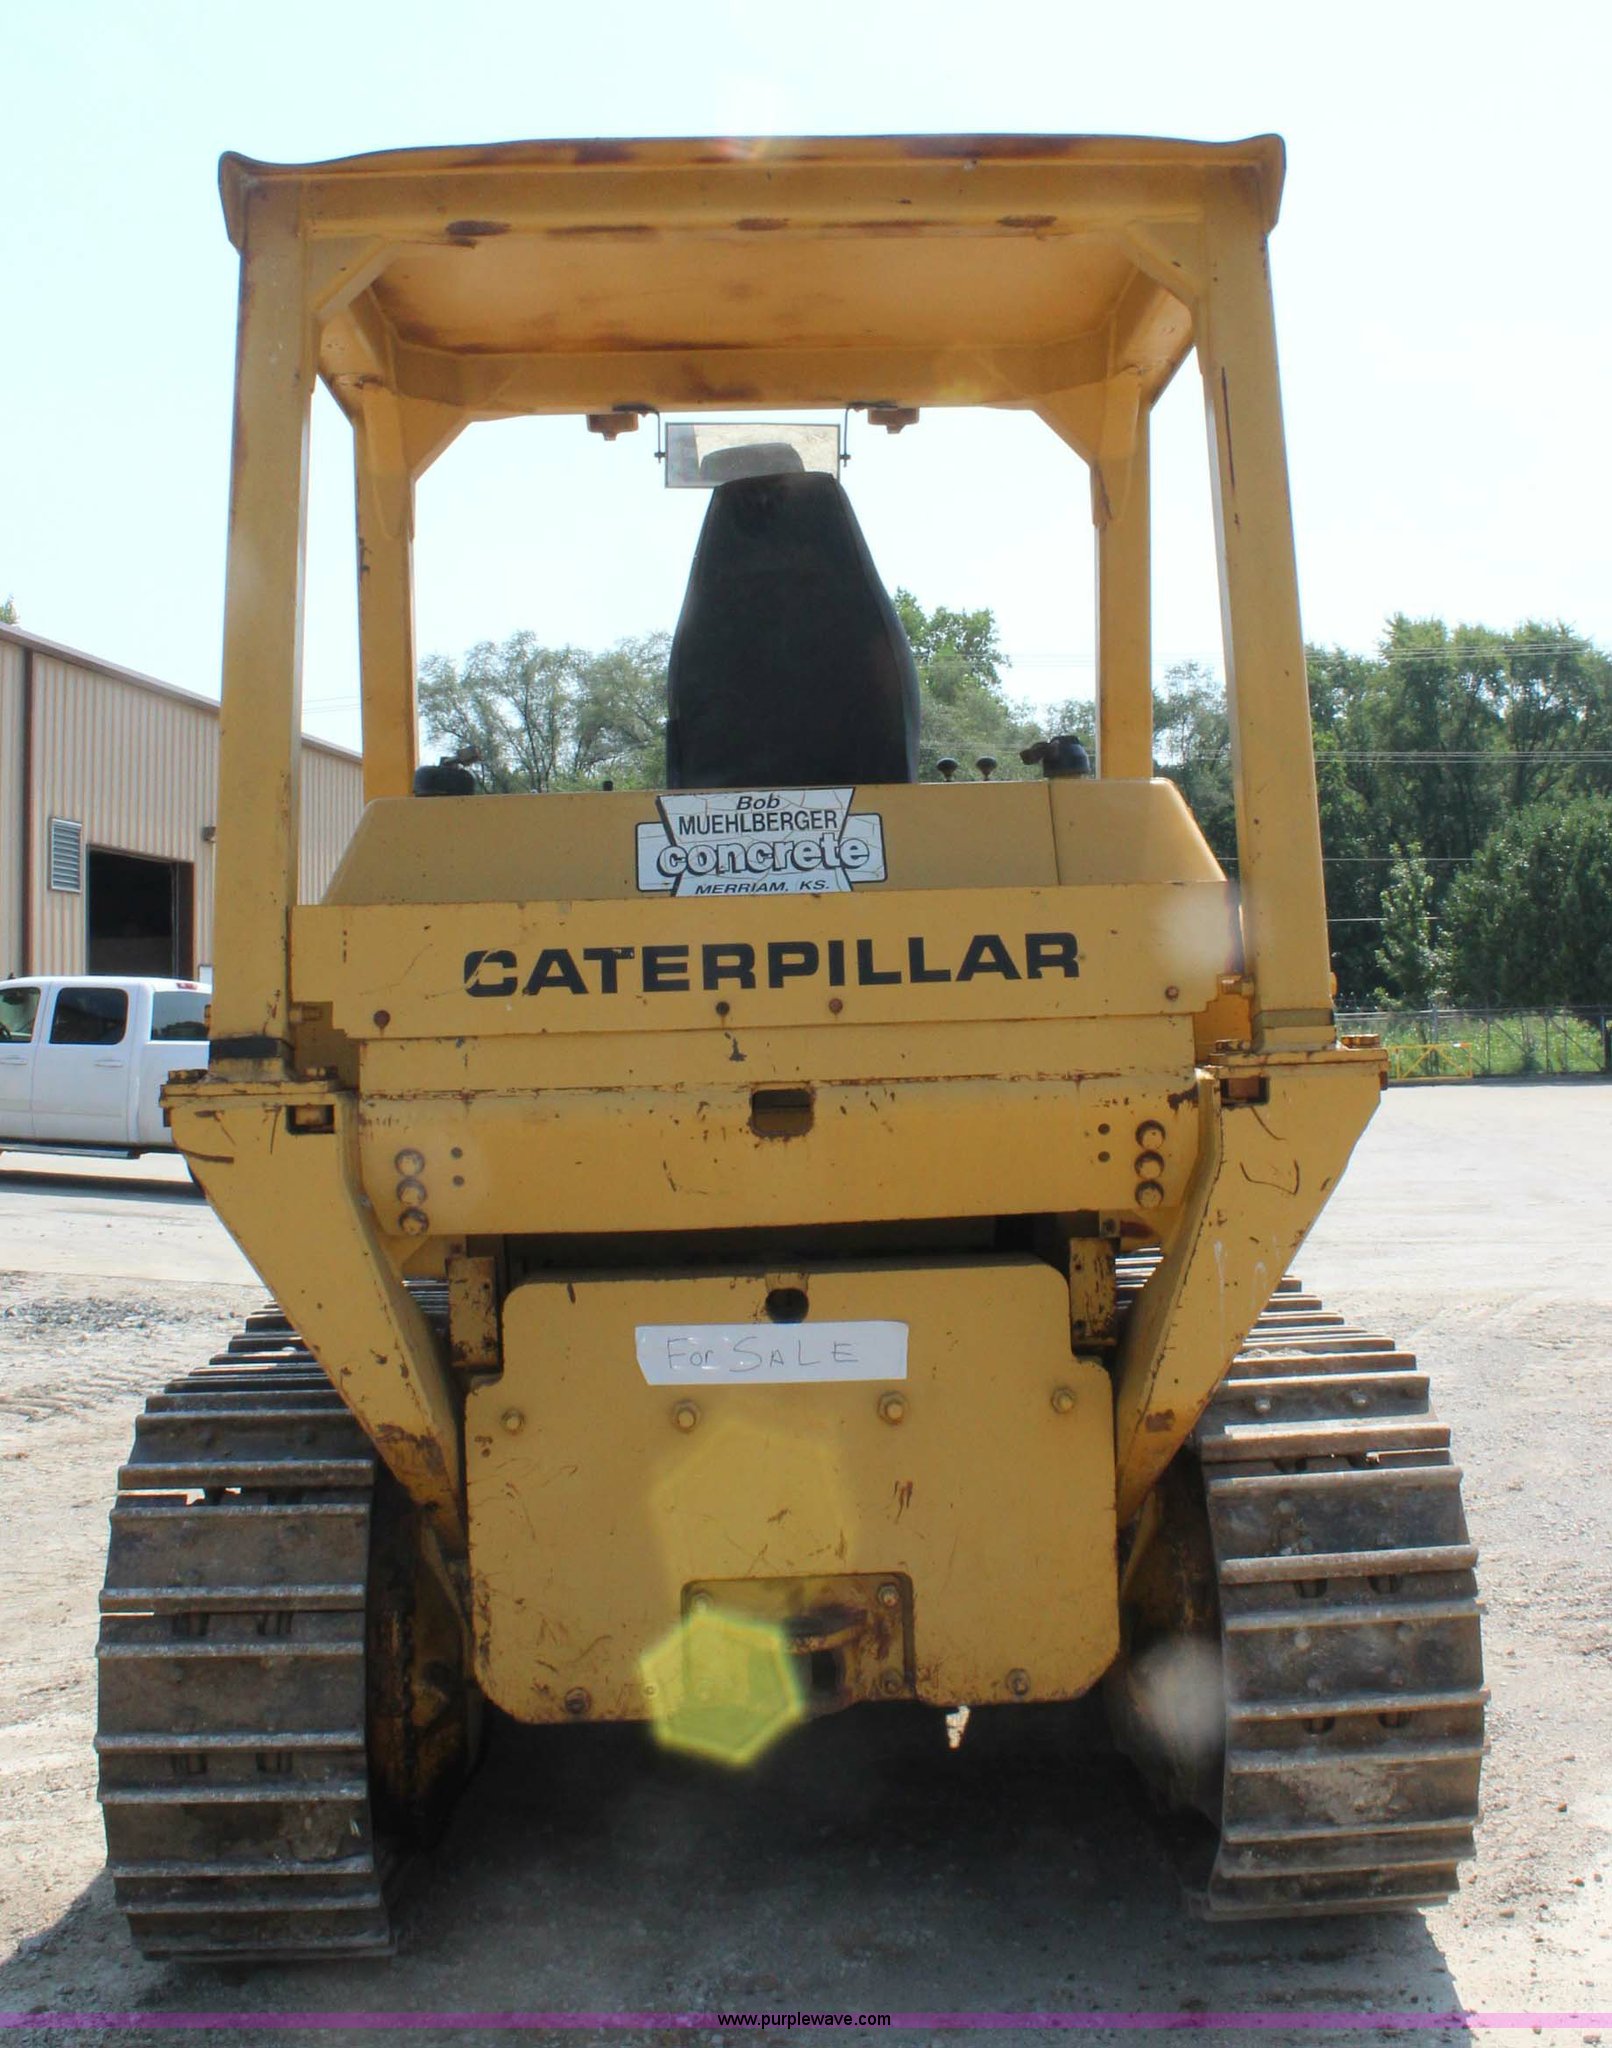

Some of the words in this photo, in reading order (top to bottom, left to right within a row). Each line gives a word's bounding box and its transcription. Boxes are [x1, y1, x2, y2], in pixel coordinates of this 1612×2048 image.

[736, 794, 780, 810] Bob
[679, 810, 837, 834] MUEHLBERGER
[657, 833, 869, 876] concrete
[799, 879, 830, 891] KS.
[463, 931, 1080, 997] CATERPILLAR
[729, 1336, 859, 1373] SALE
